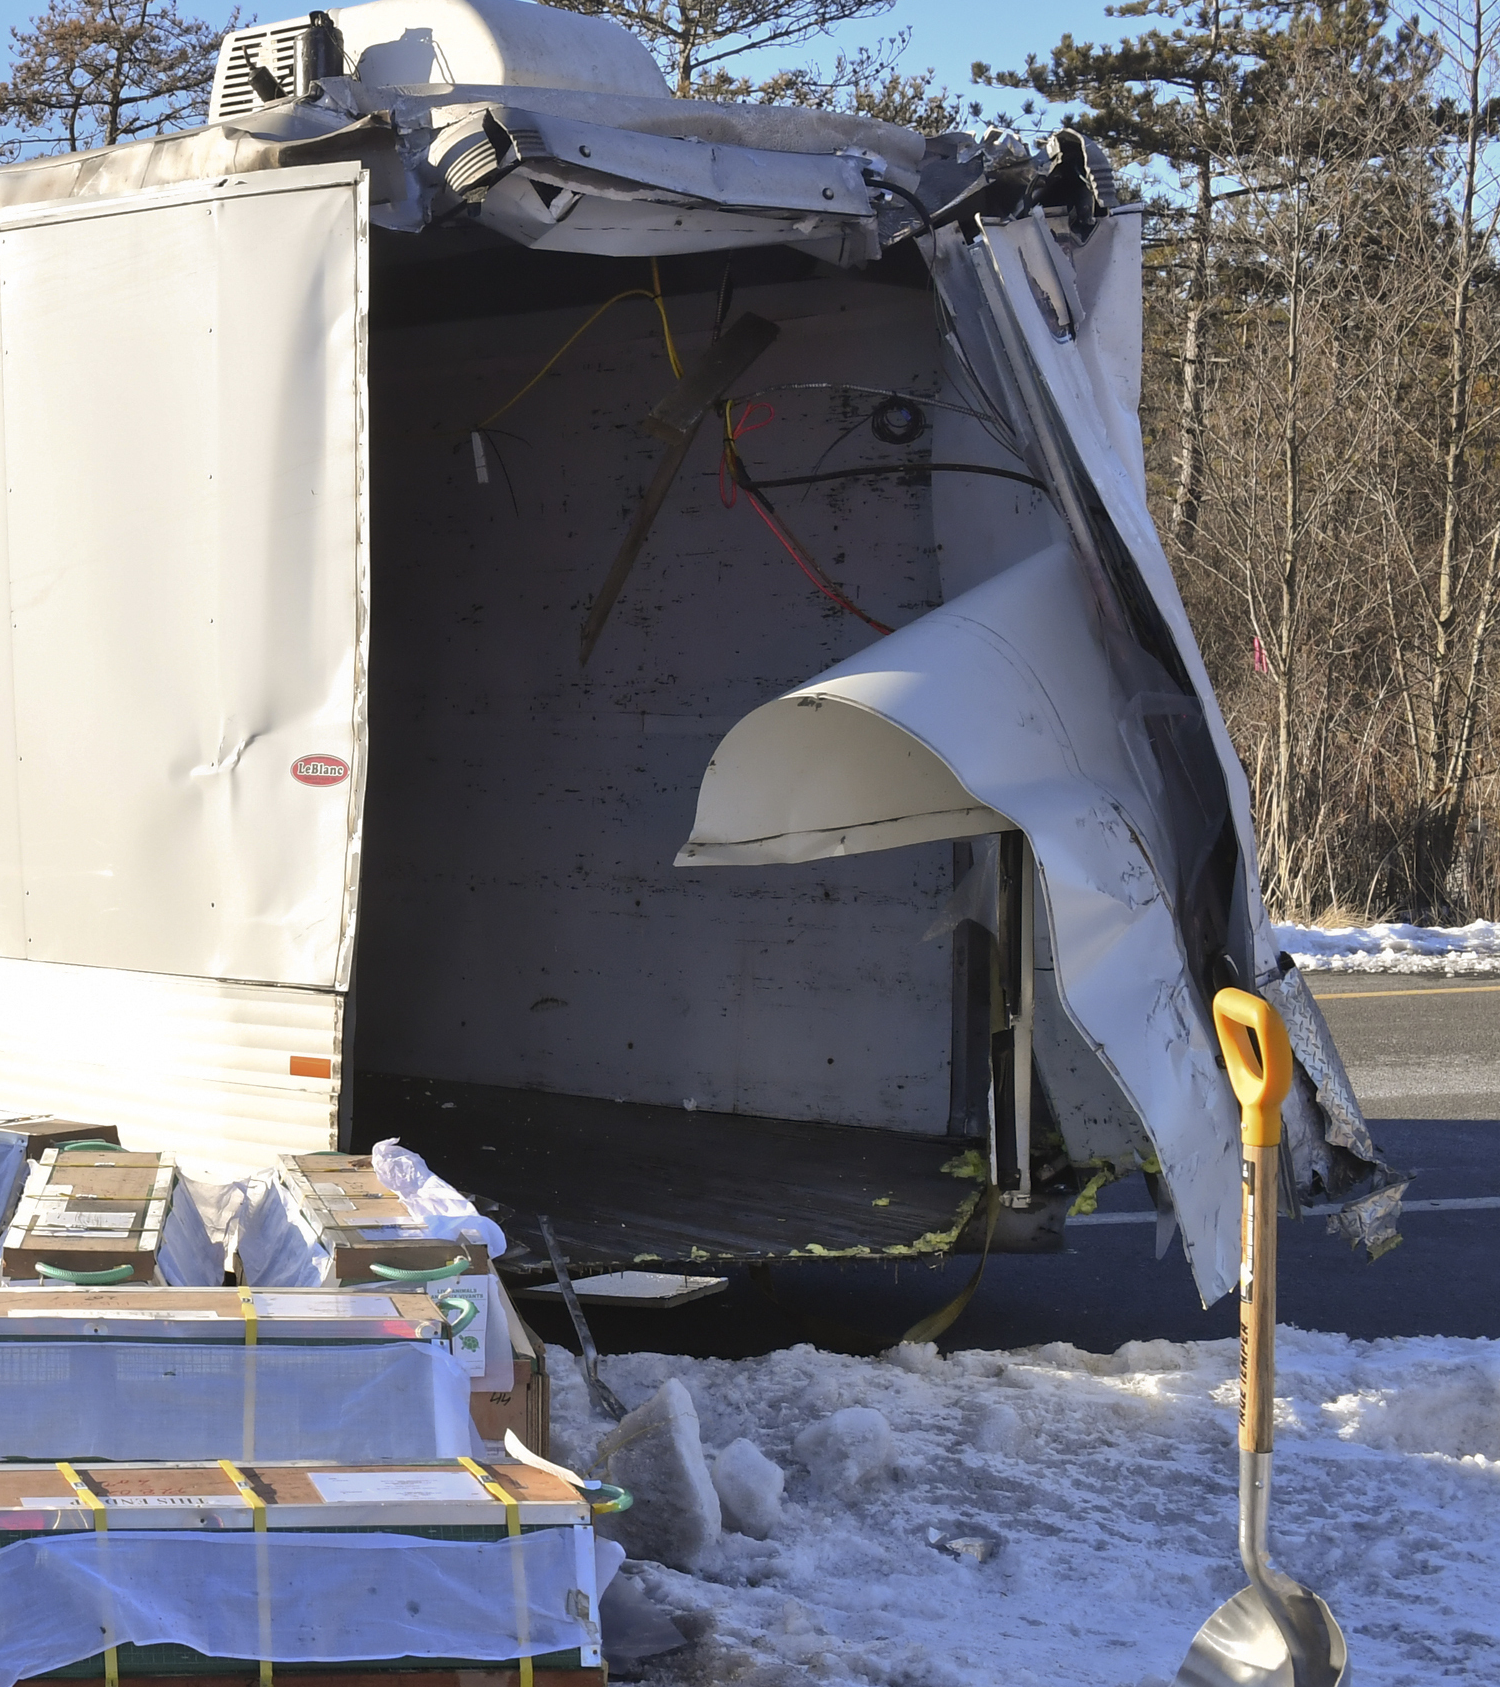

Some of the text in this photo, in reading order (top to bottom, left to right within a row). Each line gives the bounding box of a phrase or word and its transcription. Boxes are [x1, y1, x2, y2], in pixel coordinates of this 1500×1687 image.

[297, 763, 344, 775] LeBlanc
[105, 1497, 149, 1507] END
[156, 1497, 209, 1506] THIS
